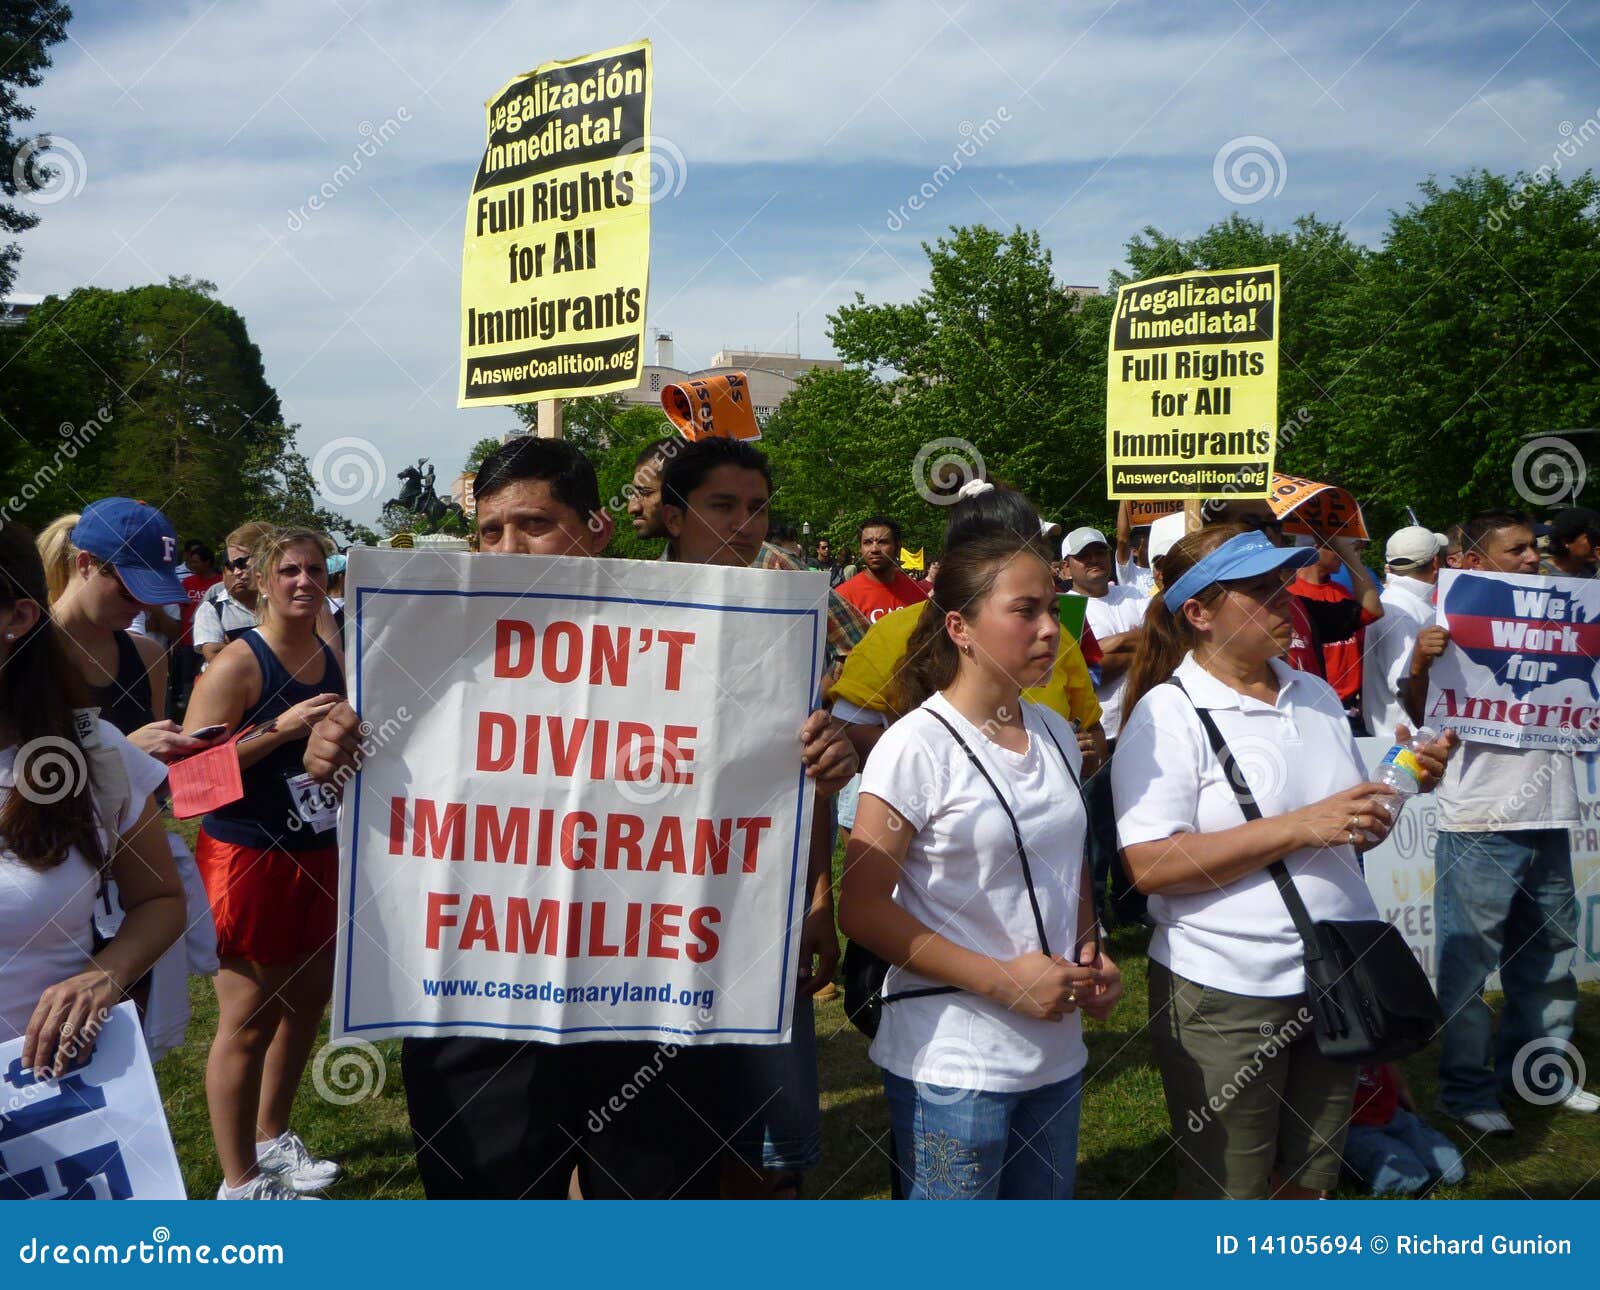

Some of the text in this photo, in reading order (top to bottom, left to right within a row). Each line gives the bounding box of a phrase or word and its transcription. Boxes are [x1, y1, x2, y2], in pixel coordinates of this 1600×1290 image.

[485, 106, 622, 174] inmediata!
[476, 170, 634, 237] Full Rights
[509, 227, 596, 284] for All
[1120, 277, 1272, 319] ¡Legalización
[468, 286, 640, 347] Immigrants
[1130, 308, 1257, 340] inmediata!
[470, 348, 635, 386] AnswerCoalition.org
[1122, 350, 1264, 382] Full Rights
[1151, 387, 1231, 417] for All
[1113, 428, 1270, 459] Immigrants
[1116, 470, 1265, 486] AnswerCoalition.org
[1131, 500, 1184, 515] Promise
[161, 536, 176, 562] F
[1512, 589, 1566, 620] We
[1490, 620, 1579, 653] Work
[493, 618, 696, 691] DON'T
[1505, 654, 1558, 683] for
[475, 711, 698, 785] DIVIDE
[1459, 725, 1501, 738] JUSTICE
[1502, 732, 1515, 740] or
[388, 796, 772, 876] IMMIGRANT
[424, 891, 721, 963] FAMILIES
[423, 978, 714, 1010] www.casademaryland.org
